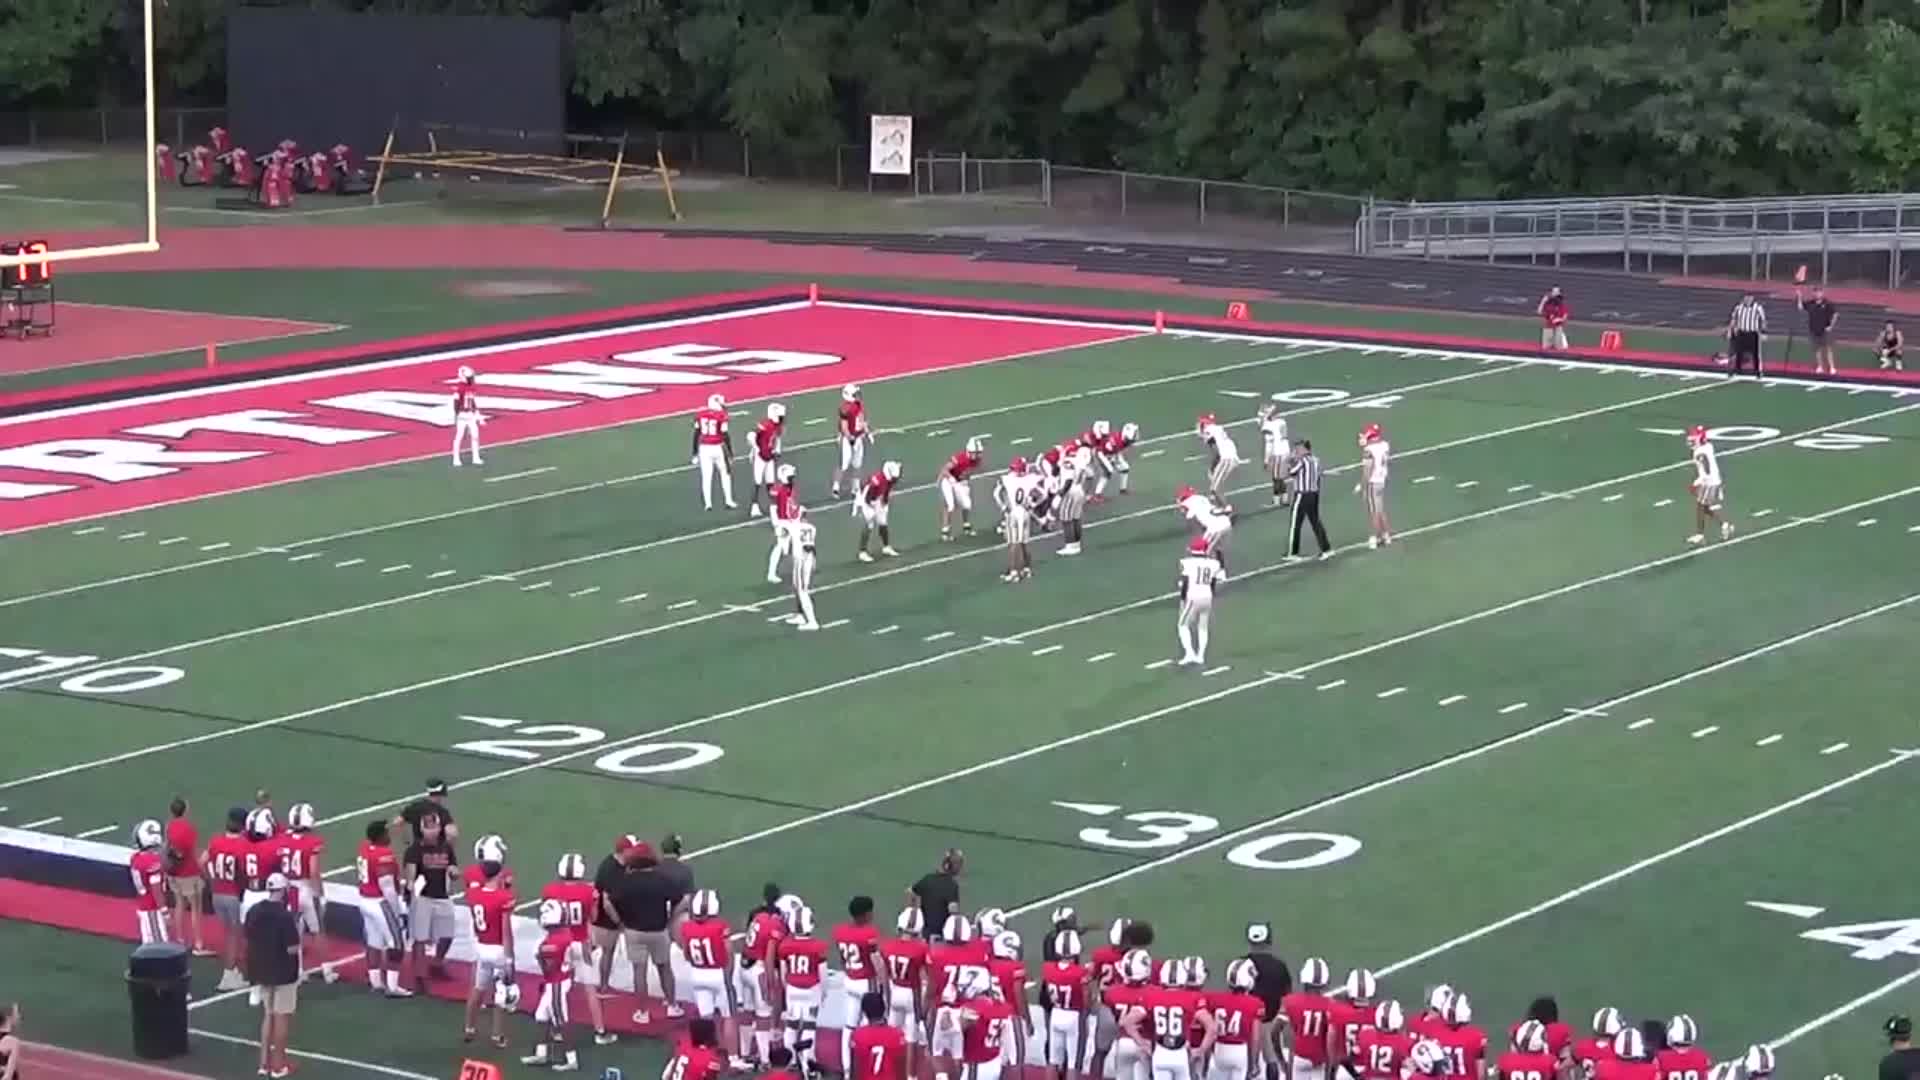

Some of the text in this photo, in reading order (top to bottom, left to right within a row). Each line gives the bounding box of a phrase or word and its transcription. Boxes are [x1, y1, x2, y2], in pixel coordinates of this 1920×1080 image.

[0, 343, 844, 499] RTANS
[1196, 565, 1212, 587] 18
[451, 725, 725, 773] 20
[1079, 811, 1362, 869] 30
[689, 937, 715, 966] 61
[787, 954, 810, 975] 18
[888, 954, 910, 980] 17
[1153, 1005, 1184, 1037] 66
[1214, 1007, 1243, 1037] 64
[1302, 1009, 1323, 1037] 11
[870, 1046, 885, 1075] 7
[1368, 1043, 1394, 1073] 12
